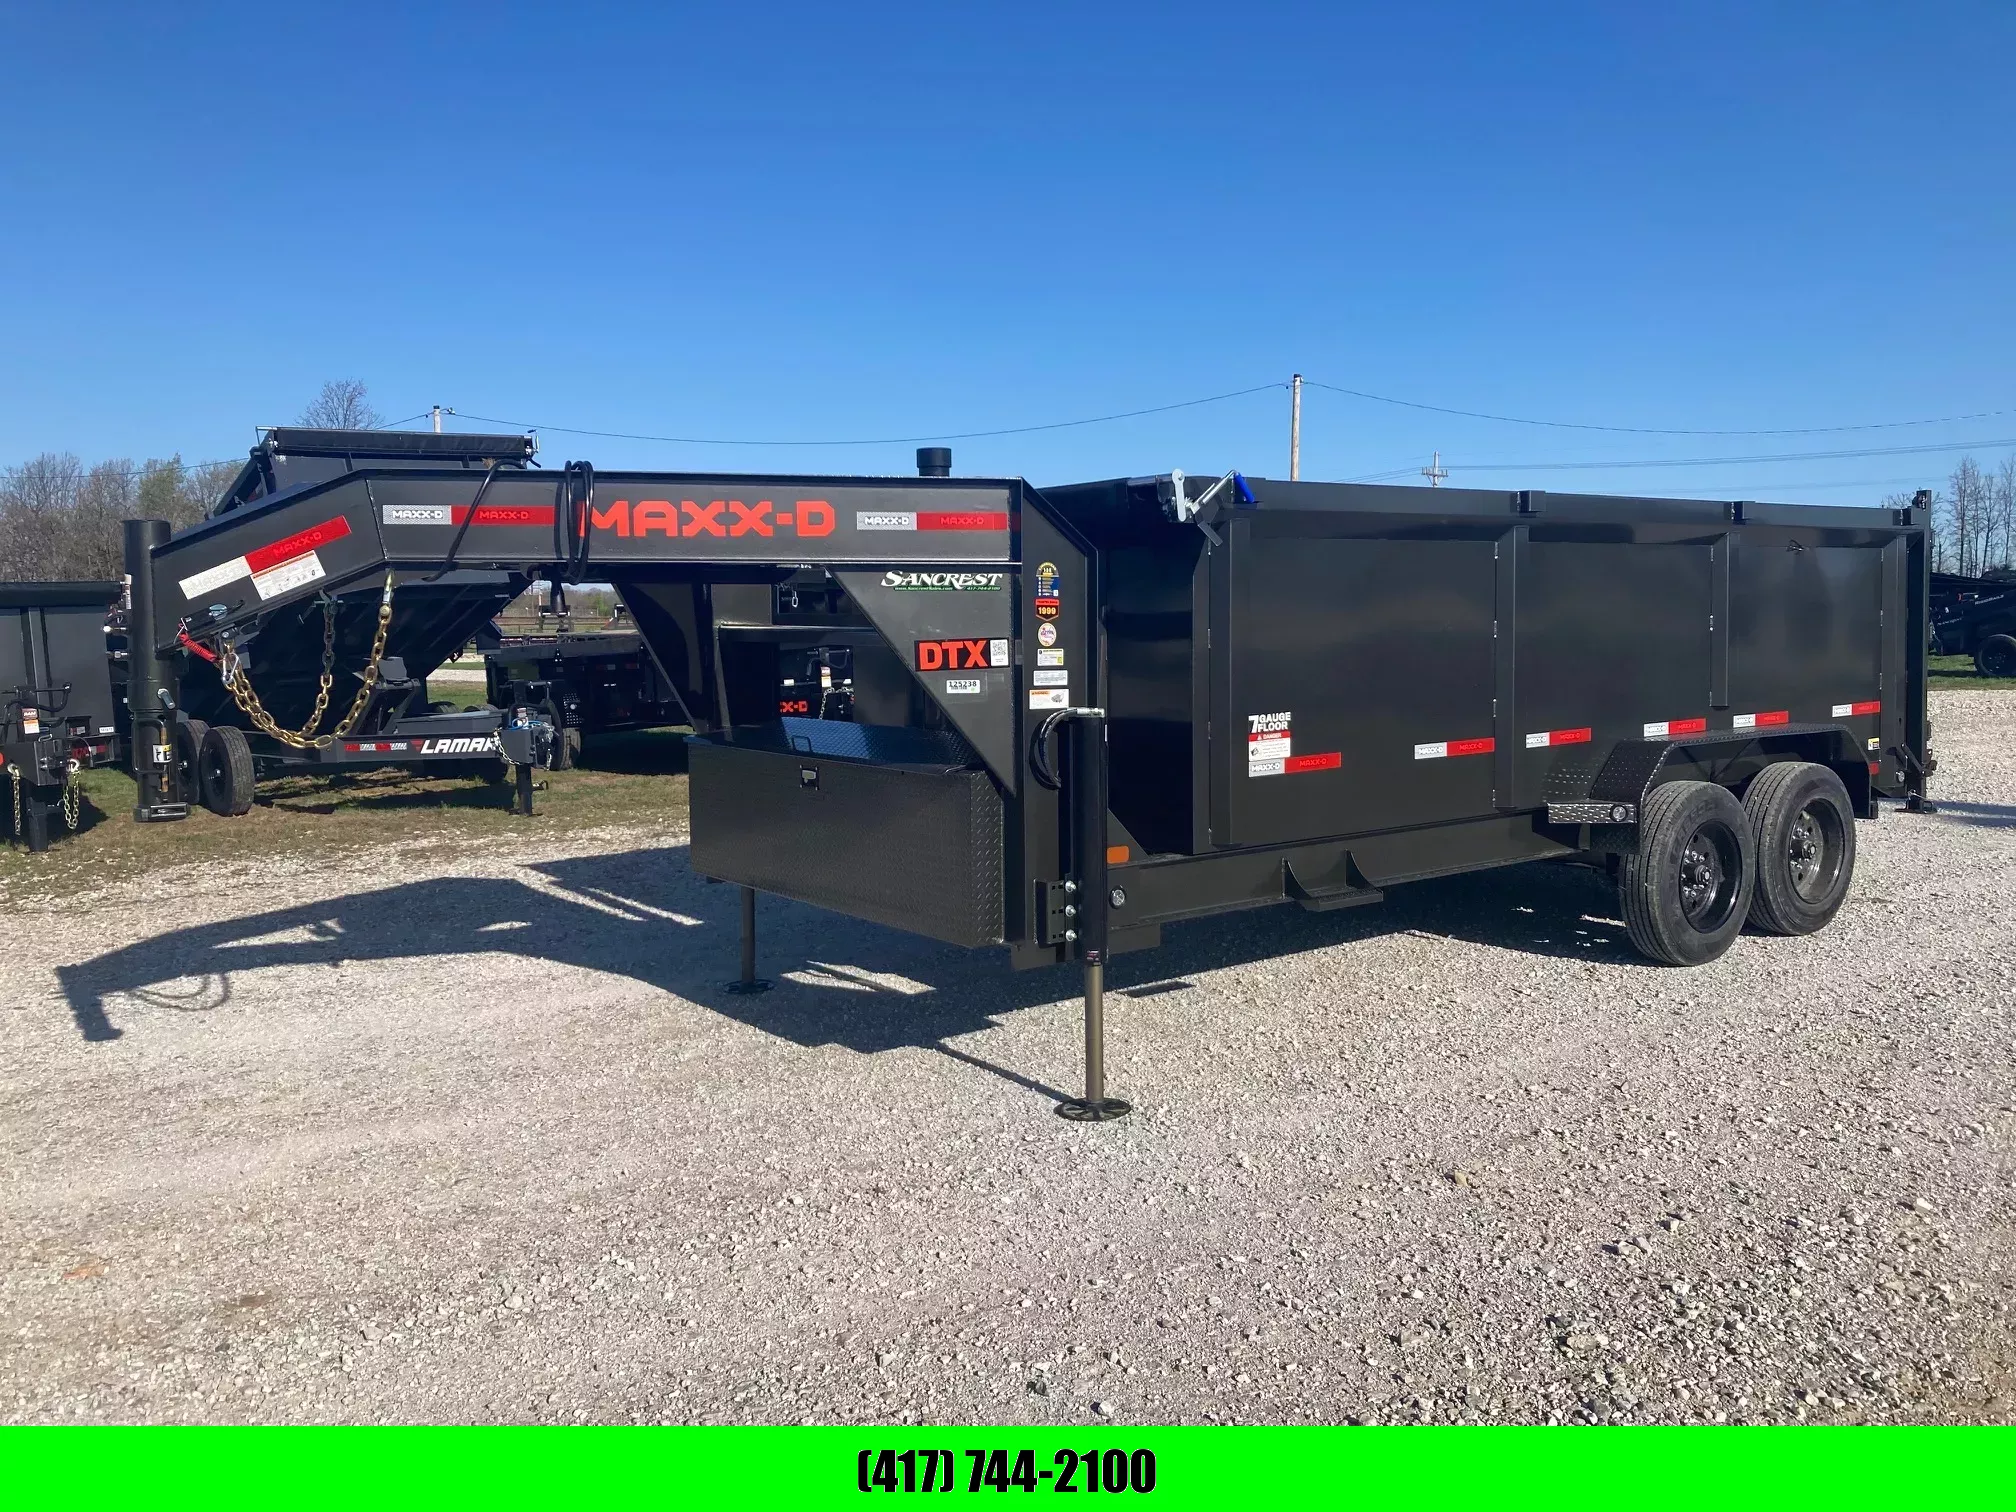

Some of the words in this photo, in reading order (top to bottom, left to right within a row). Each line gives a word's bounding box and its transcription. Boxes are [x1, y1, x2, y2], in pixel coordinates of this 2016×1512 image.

[392, 510, 443, 519] MAXX-D
[479, 510, 529, 520] MAXX-D
[577, 501, 836, 537] MAXX-D
[864, 516, 909, 525] MAXX-D
[940, 516, 984, 525] MAXX-D
[272, 531, 323, 558] MAXX-D
[1038, 606, 1056, 615] 1999
[918, 640, 988, 670] DTX
[780, 701, 808, 713] X-D
[1248, 715, 1259, 733] 7
[1259, 712, 1292, 723] GAUGE
[1258, 721, 1289, 732] FLOOR
[1251, 762, 1280, 772] MAXX-D
[1300, 758, 1327, 767] MAXX-D
